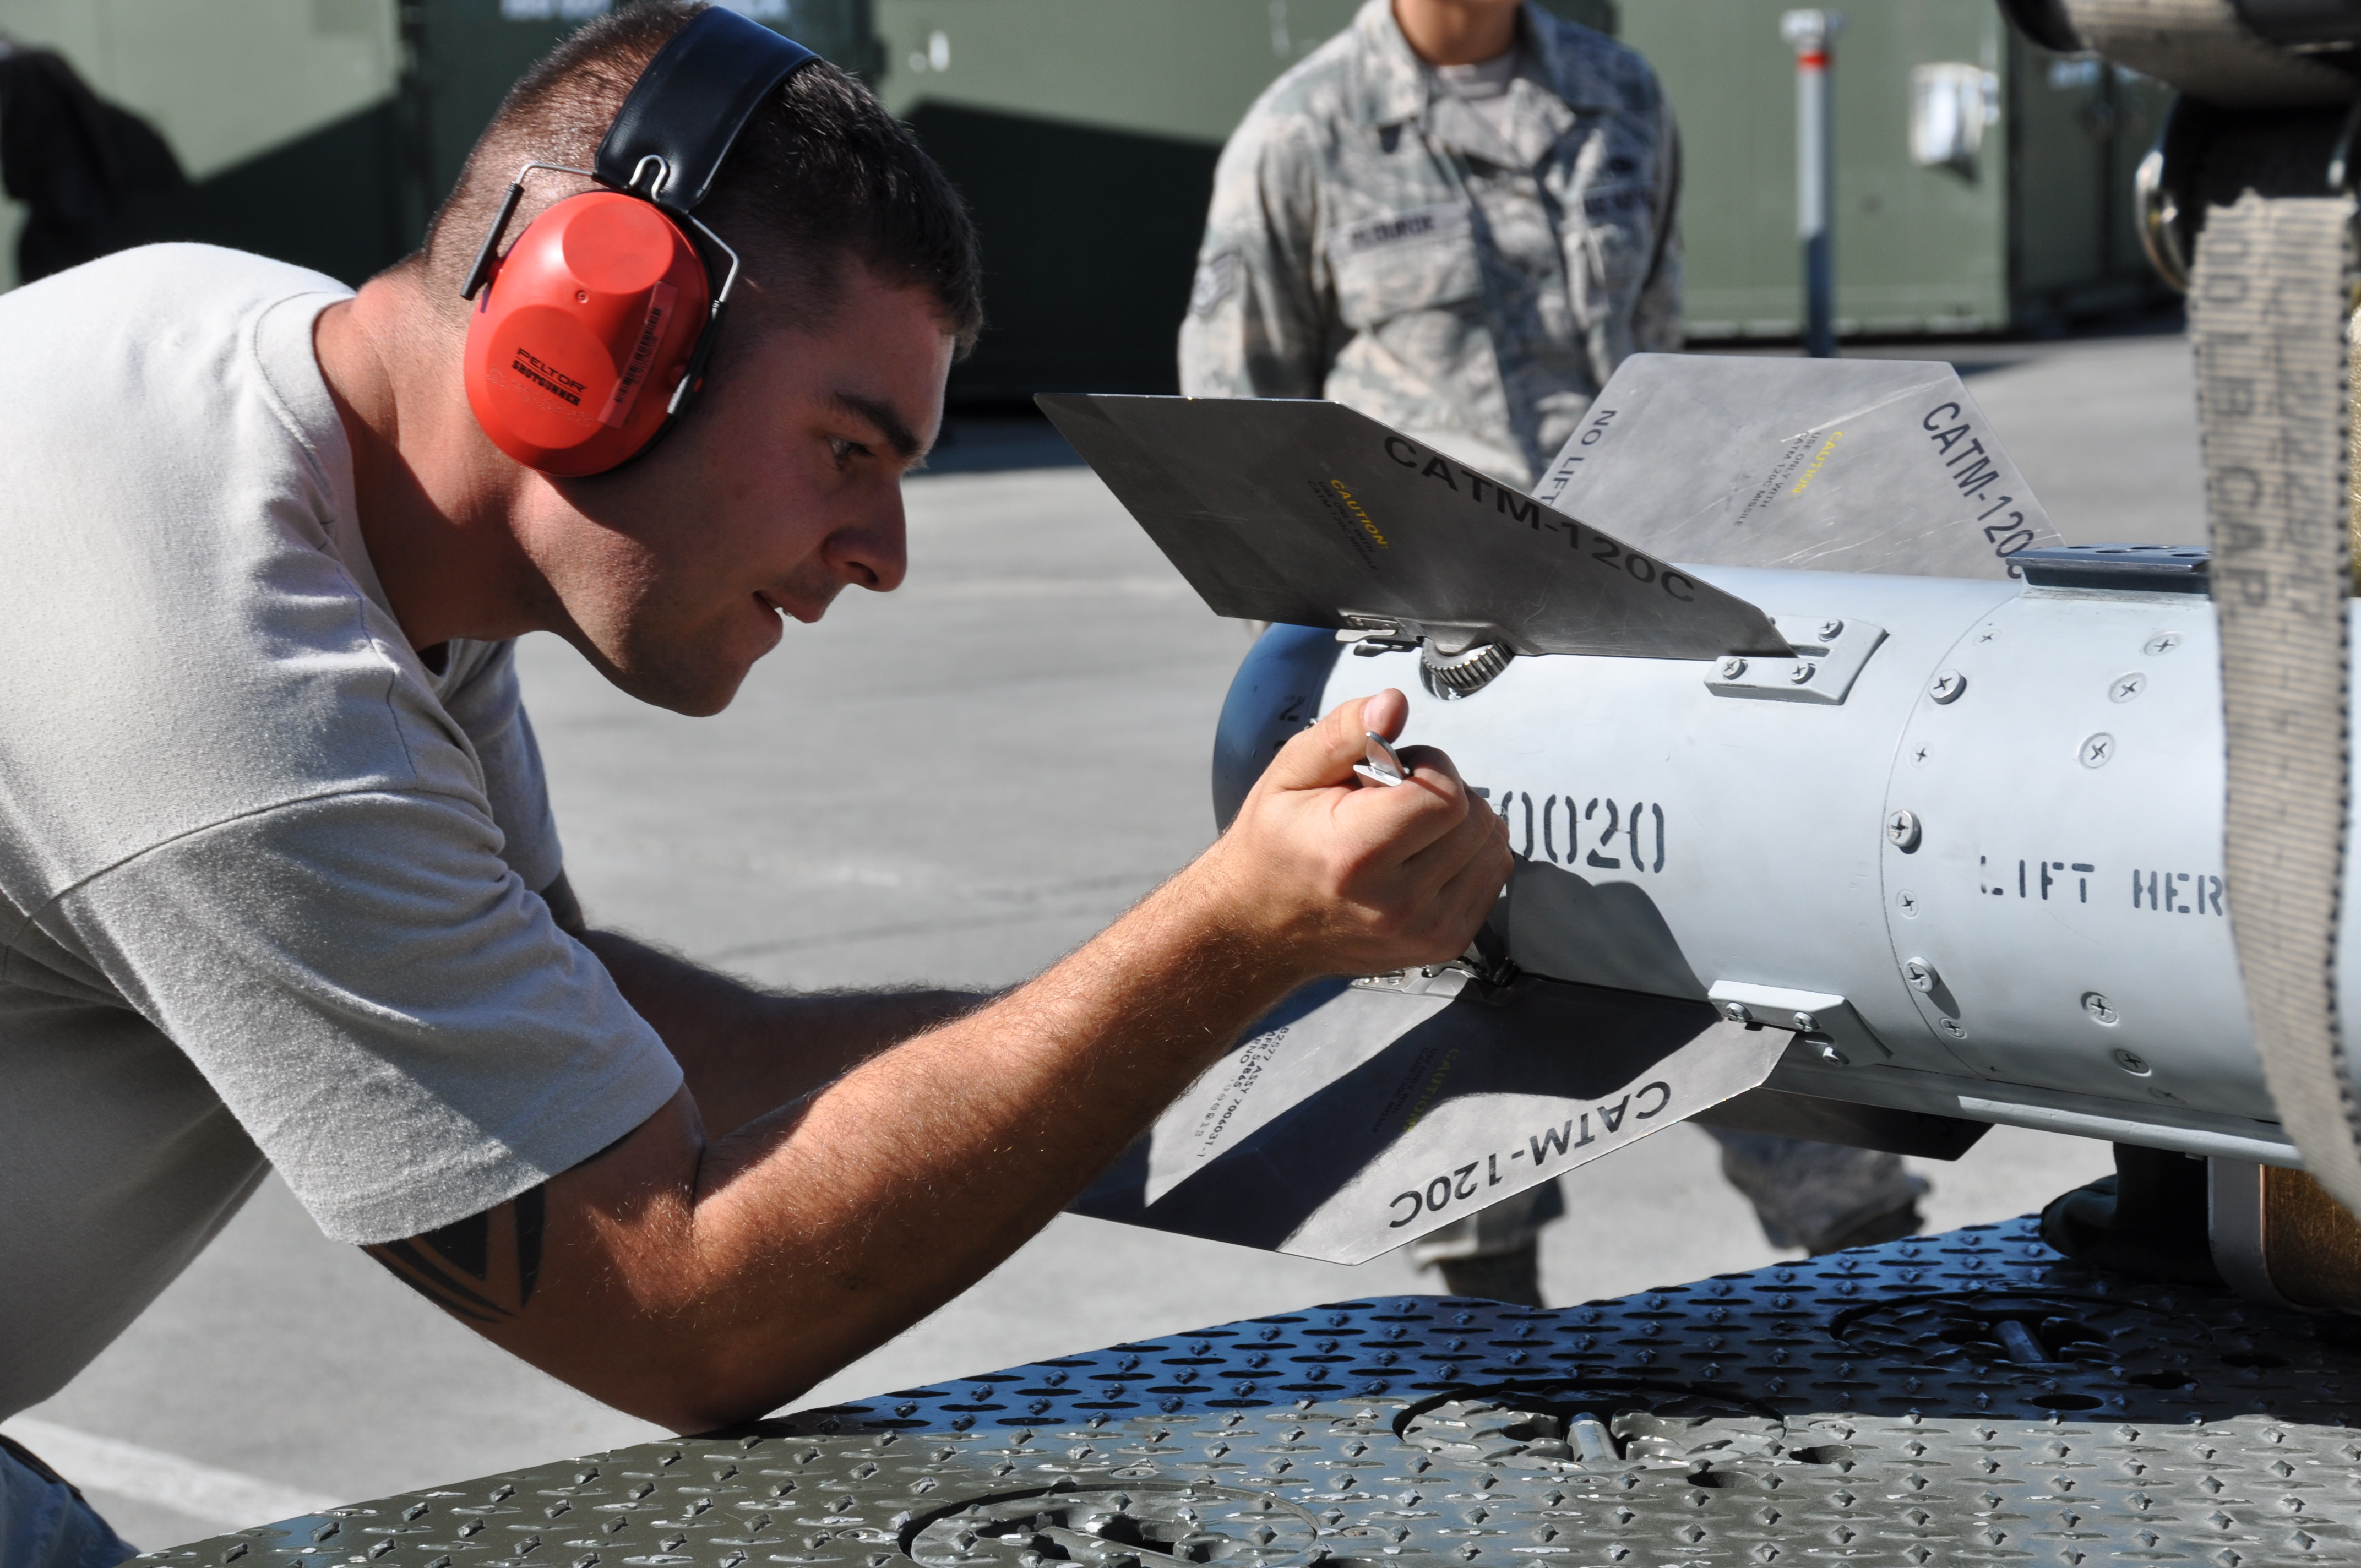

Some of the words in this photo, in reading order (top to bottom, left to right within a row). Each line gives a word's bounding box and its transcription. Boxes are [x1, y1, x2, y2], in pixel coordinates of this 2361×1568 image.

[512, 360, 581, 407] SHOTGUNNER
[517, 347, 587, 393] PELTOR
[1581, 410, 1618, 445] NO
[1802, 432, 1821, 450] USE
[1540, 456, 1585, 505] LIFT
[1782, 454, 1804, 479] ONLY
[1736, 489, 1766, 526] MISSILE
[1760, 482, 1784, 508] WITH
[1334, 501, 1355, 526] ONLY
[1353, 529, 1375, 553] WITH
[1384, 436, 1695, 603] CATM-120C
[1470, 786, 1665, 874] 0020
[1981, 855, 2095, 903] LIFT
[1263, 1027, 1290, 1061] 82577
[1233, 1053, 1261, 1088] 54865
[1240, 1065, 1263, 1094] ASSY
[1196, 1098, 1243, 1157] 7006031-1
[1389, 1080, 1672, 1229] CATM-120C
